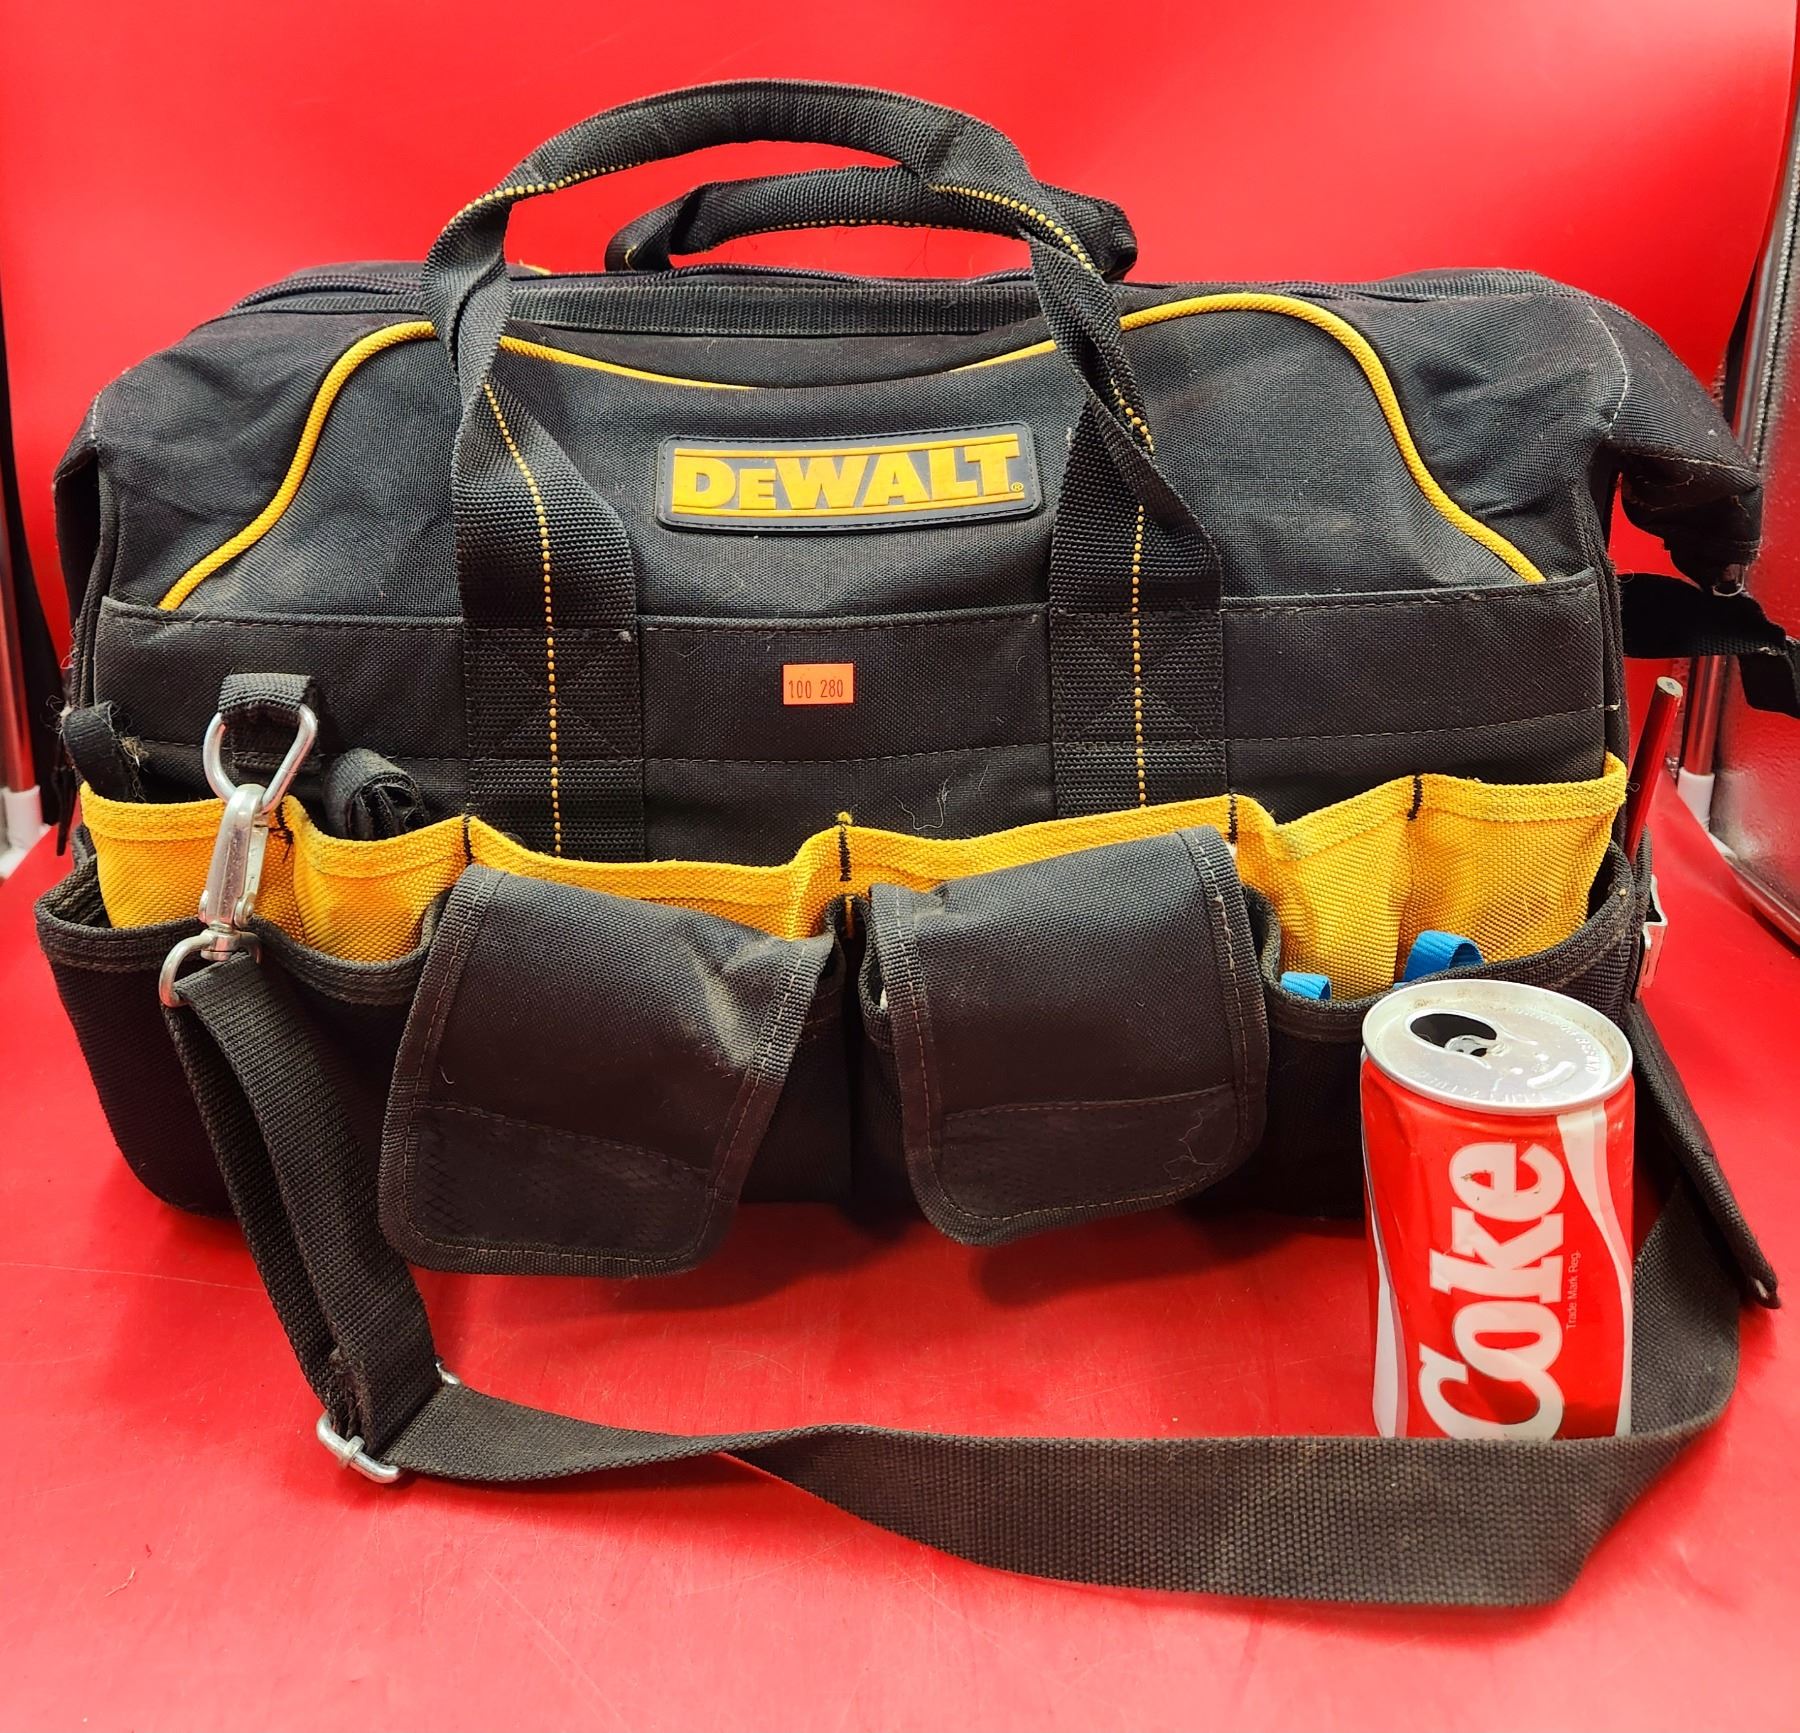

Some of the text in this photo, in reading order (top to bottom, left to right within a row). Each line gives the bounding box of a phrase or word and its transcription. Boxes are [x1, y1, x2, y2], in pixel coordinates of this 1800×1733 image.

[789, 679, 844, 699] 100 280
[1418, 1141, 1566, 1441] Coke
[1567, 1275, 1578, 1300] Mark
[1566, 1302, 1578, 1331] Trade
